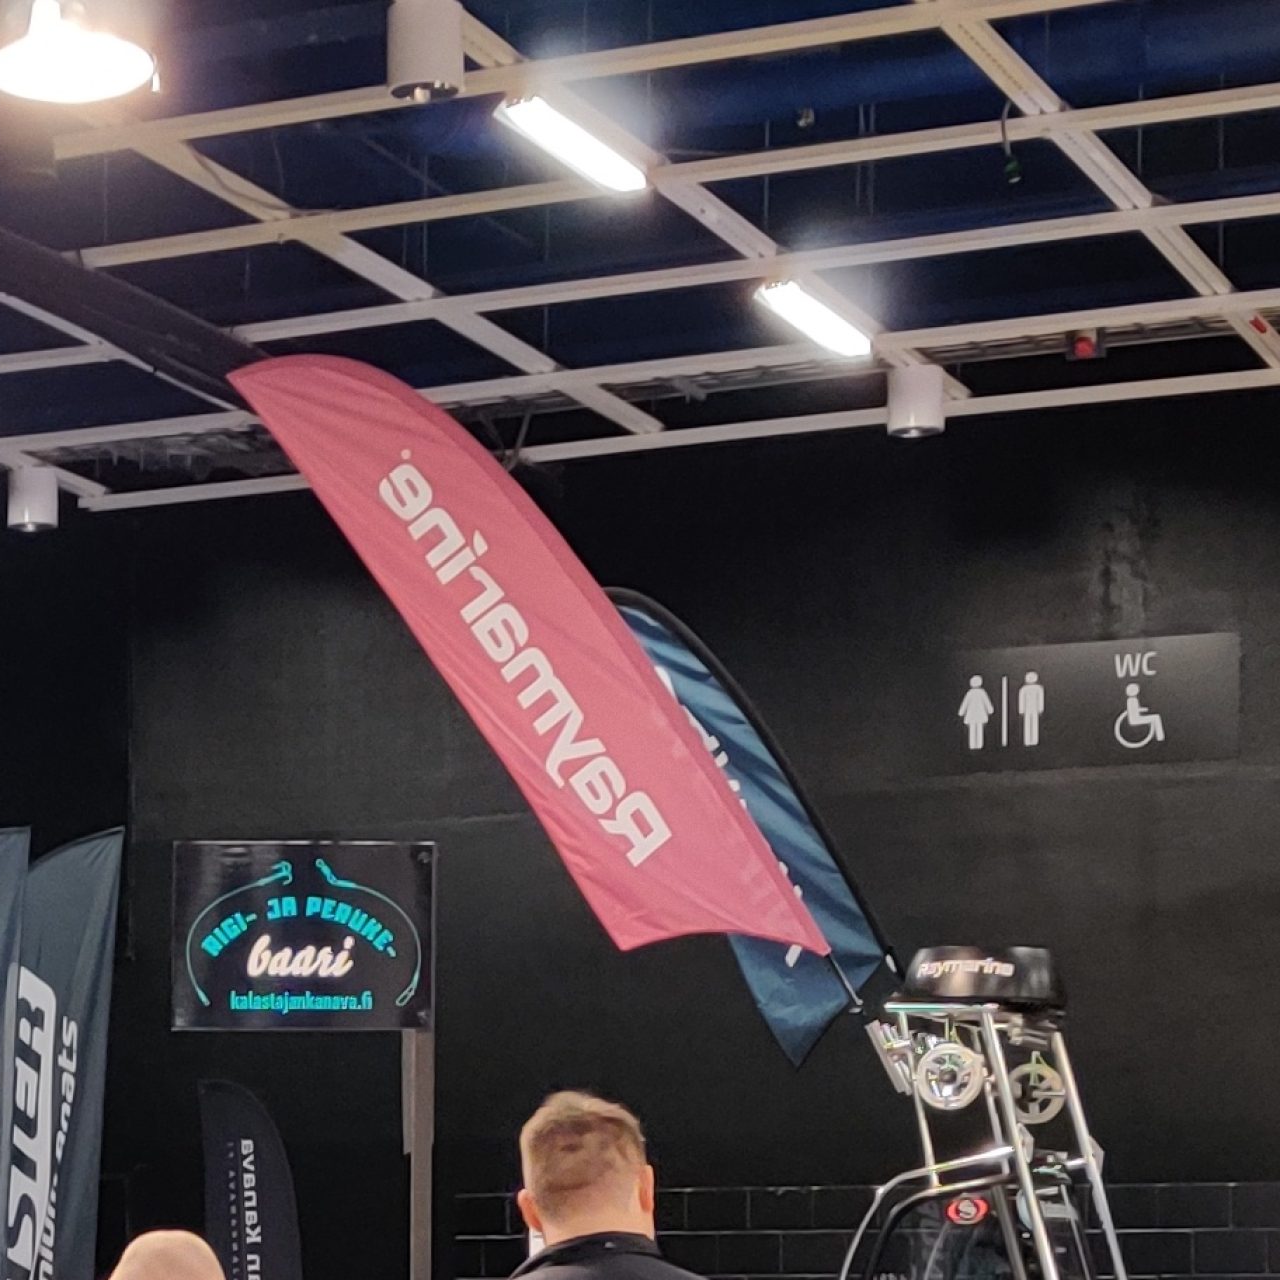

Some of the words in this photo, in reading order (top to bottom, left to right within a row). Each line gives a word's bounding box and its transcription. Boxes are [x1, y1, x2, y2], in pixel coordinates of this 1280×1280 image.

[1114, 651, 1157, 678] WC
[247, 934, 356, 978] baari
[230, 991, 373, 1014] kalastajankanava.fi
